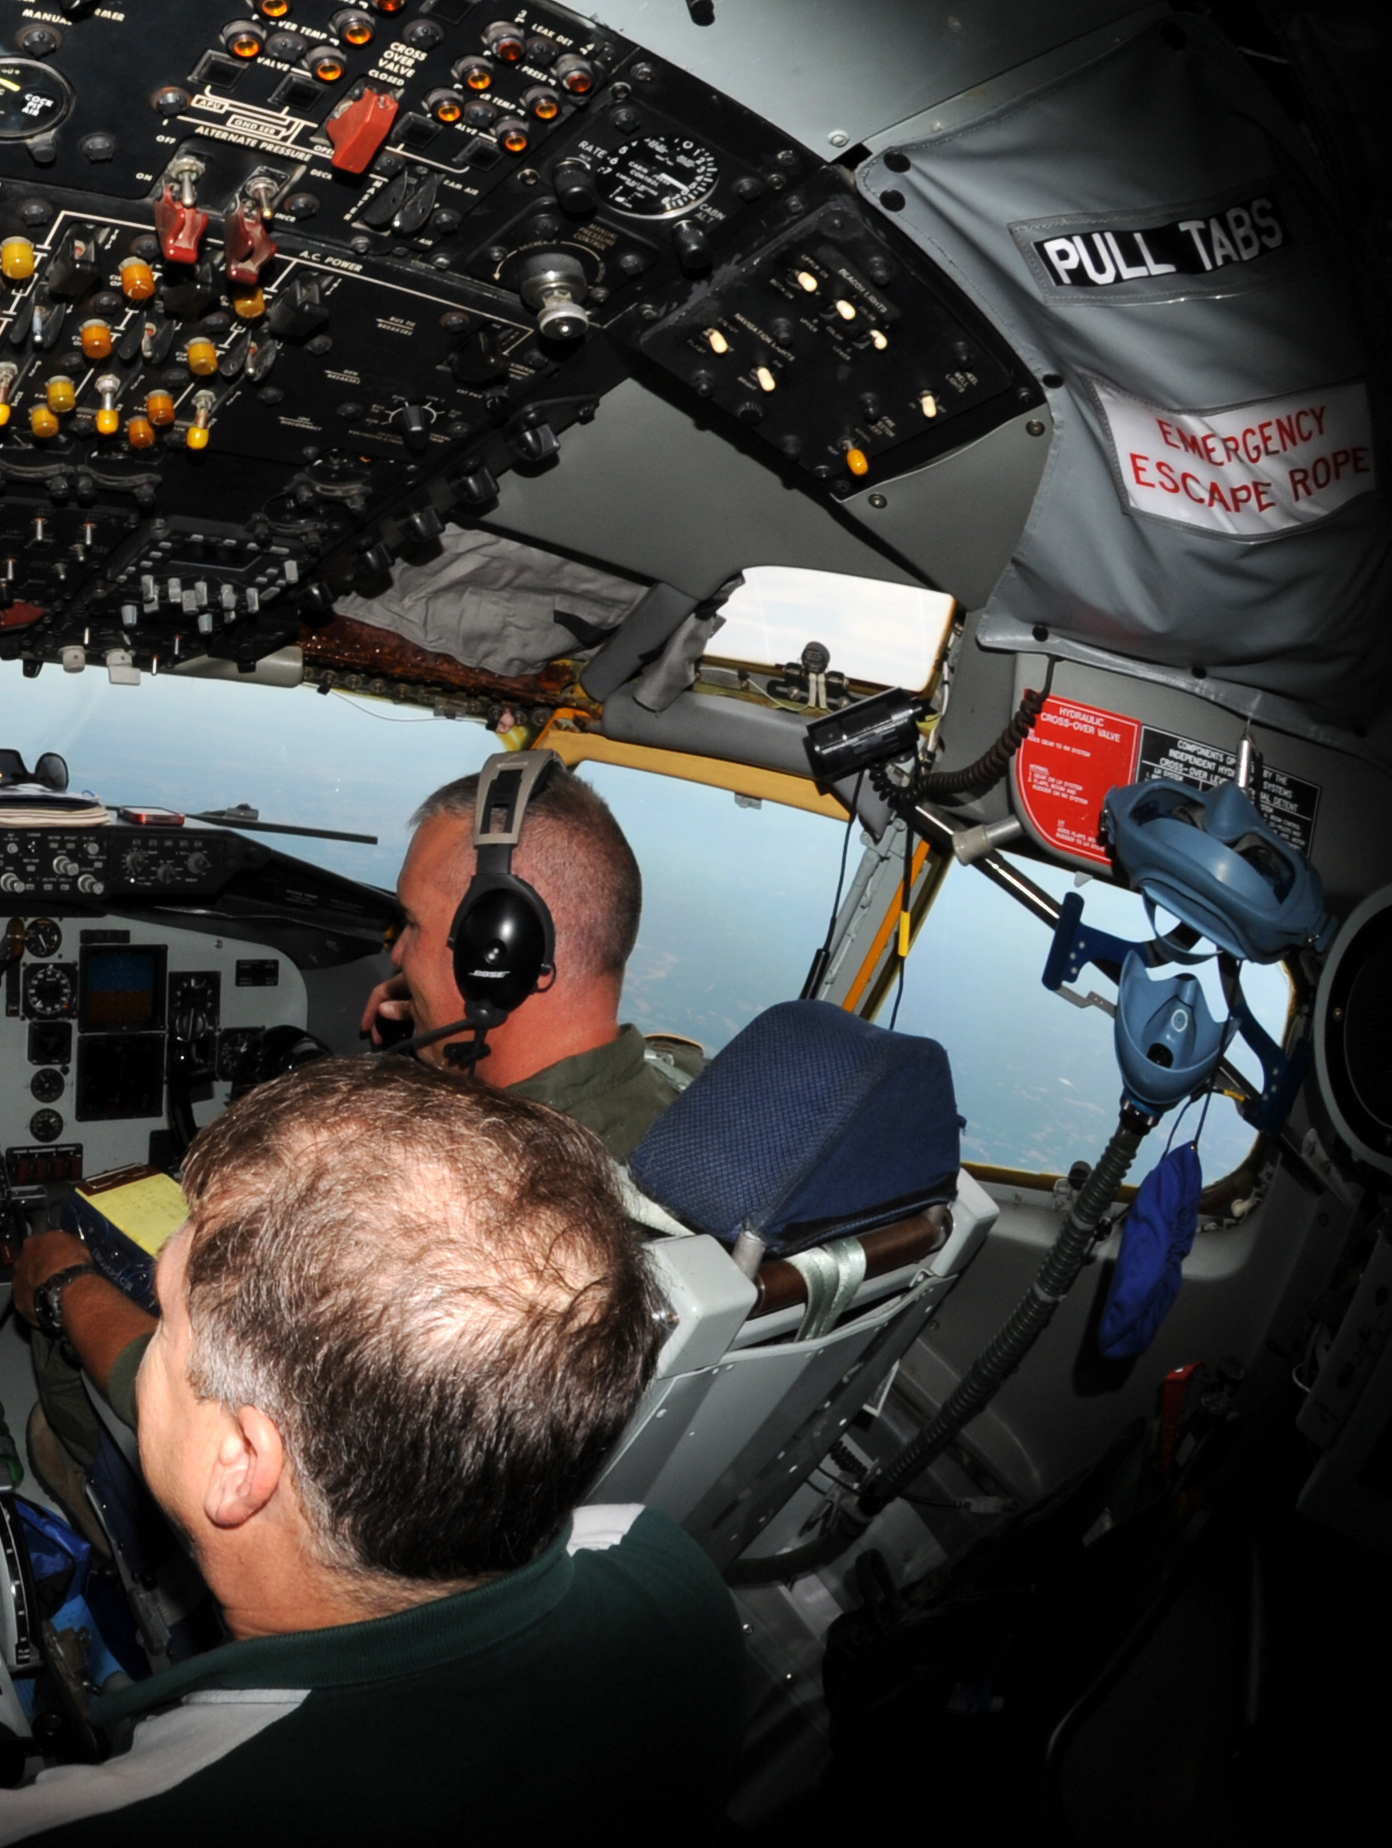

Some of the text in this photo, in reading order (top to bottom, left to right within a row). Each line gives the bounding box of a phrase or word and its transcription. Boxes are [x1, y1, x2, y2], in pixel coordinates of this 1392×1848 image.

[21, 8, 73, 26] MANUA
[300, 25, 328, 41] TEMP
[531, 22, 575, 48] LEAK DET
[383, 50, 416, 69] OVER
[390, 41, 428, 62] CROSS
[257, 56, 292, 72] VALVE
[377, 58, 416, 79] VALVE
[368, 68, 406, 88] CLOSED
[521, 65, 548, 84] PRESS
[24, 93, 55, 108] COCK
[26, 101, 42, 109] PIT
[198, 97, 224, 111] APU
[491, 96, 517, 112] TEMP
[21, 107, 40, 117] AIR
[234, 119, 277, 136] GND SER
[454, 122, 479, 136] ALVE
[155, 134, 177, 145] OFF
[194, 125, 314, 163] ALTERNATE PRESSURE
[578, 140, 608, 159] RATE
[135, 172, 153, 182] ON
[443, 178, 479, 197] RAM AIR
[694, 211, 715, 224] ALT
[698, 203, 727, 222] CABIN
[576, 226, 617, 248] PRESSURE
[587, 222, 619, 240] MANUAL
[418, 238, 434, 247] AIR
[572, 231, 608, 252] CONTROL
[1043, 196, 1284, 287] PULL TABS
[298, 250, 364, 273] A.C. POWER
[838, 267, 888, 314] BEACON LIGHTS
[376, 322, 414, 337] BREAKERS
[734, 313, 796, 362] NAVIGATION LIGHTS
[325, 372, 362, 386] BREAKERS
[1155, 405, 1329, 468] EMERGENCY
[1128, 446, 1373, 514] ESCAPE ROPE
[1059, 706, 1106, 728] HYDRAULIC
[1040, 712, 1123, 743] CROSS-OVER VALVE
[1168, 748, 1217, 772] INDEPENDENT
[1177, 740, 1225, 763] COMPONENTS
[1188, 766, 1209, 783] OVER
[1262, 768, 1289, 786] BY THE
[1262, 780, 1294, 799] SYSTEMS
[1273, 796, 1300, 813] DETENT
